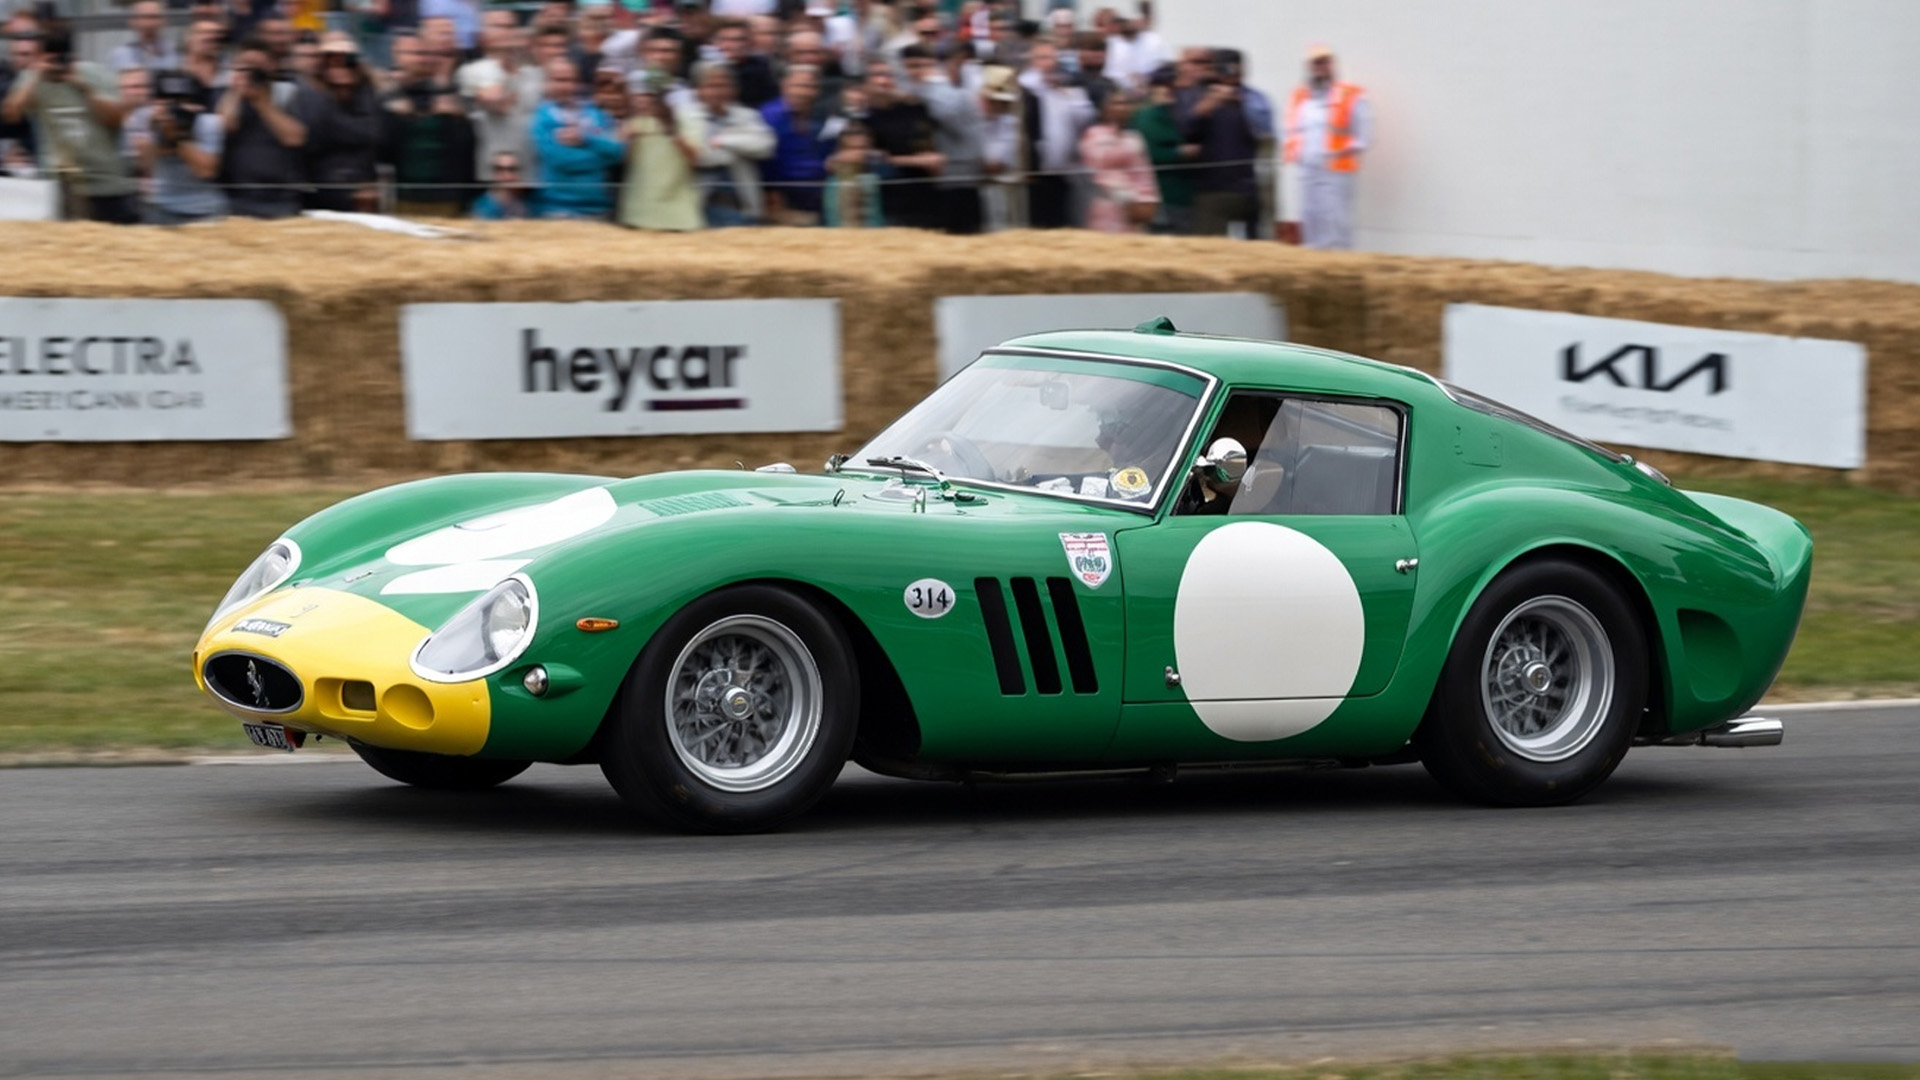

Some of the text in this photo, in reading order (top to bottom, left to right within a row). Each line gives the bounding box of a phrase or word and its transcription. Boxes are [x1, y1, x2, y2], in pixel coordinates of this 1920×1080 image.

[521, 329, 746, 411] heycar
[1560, 344, 1730, 394] KIA
[912, 587, 950, 609] 314
